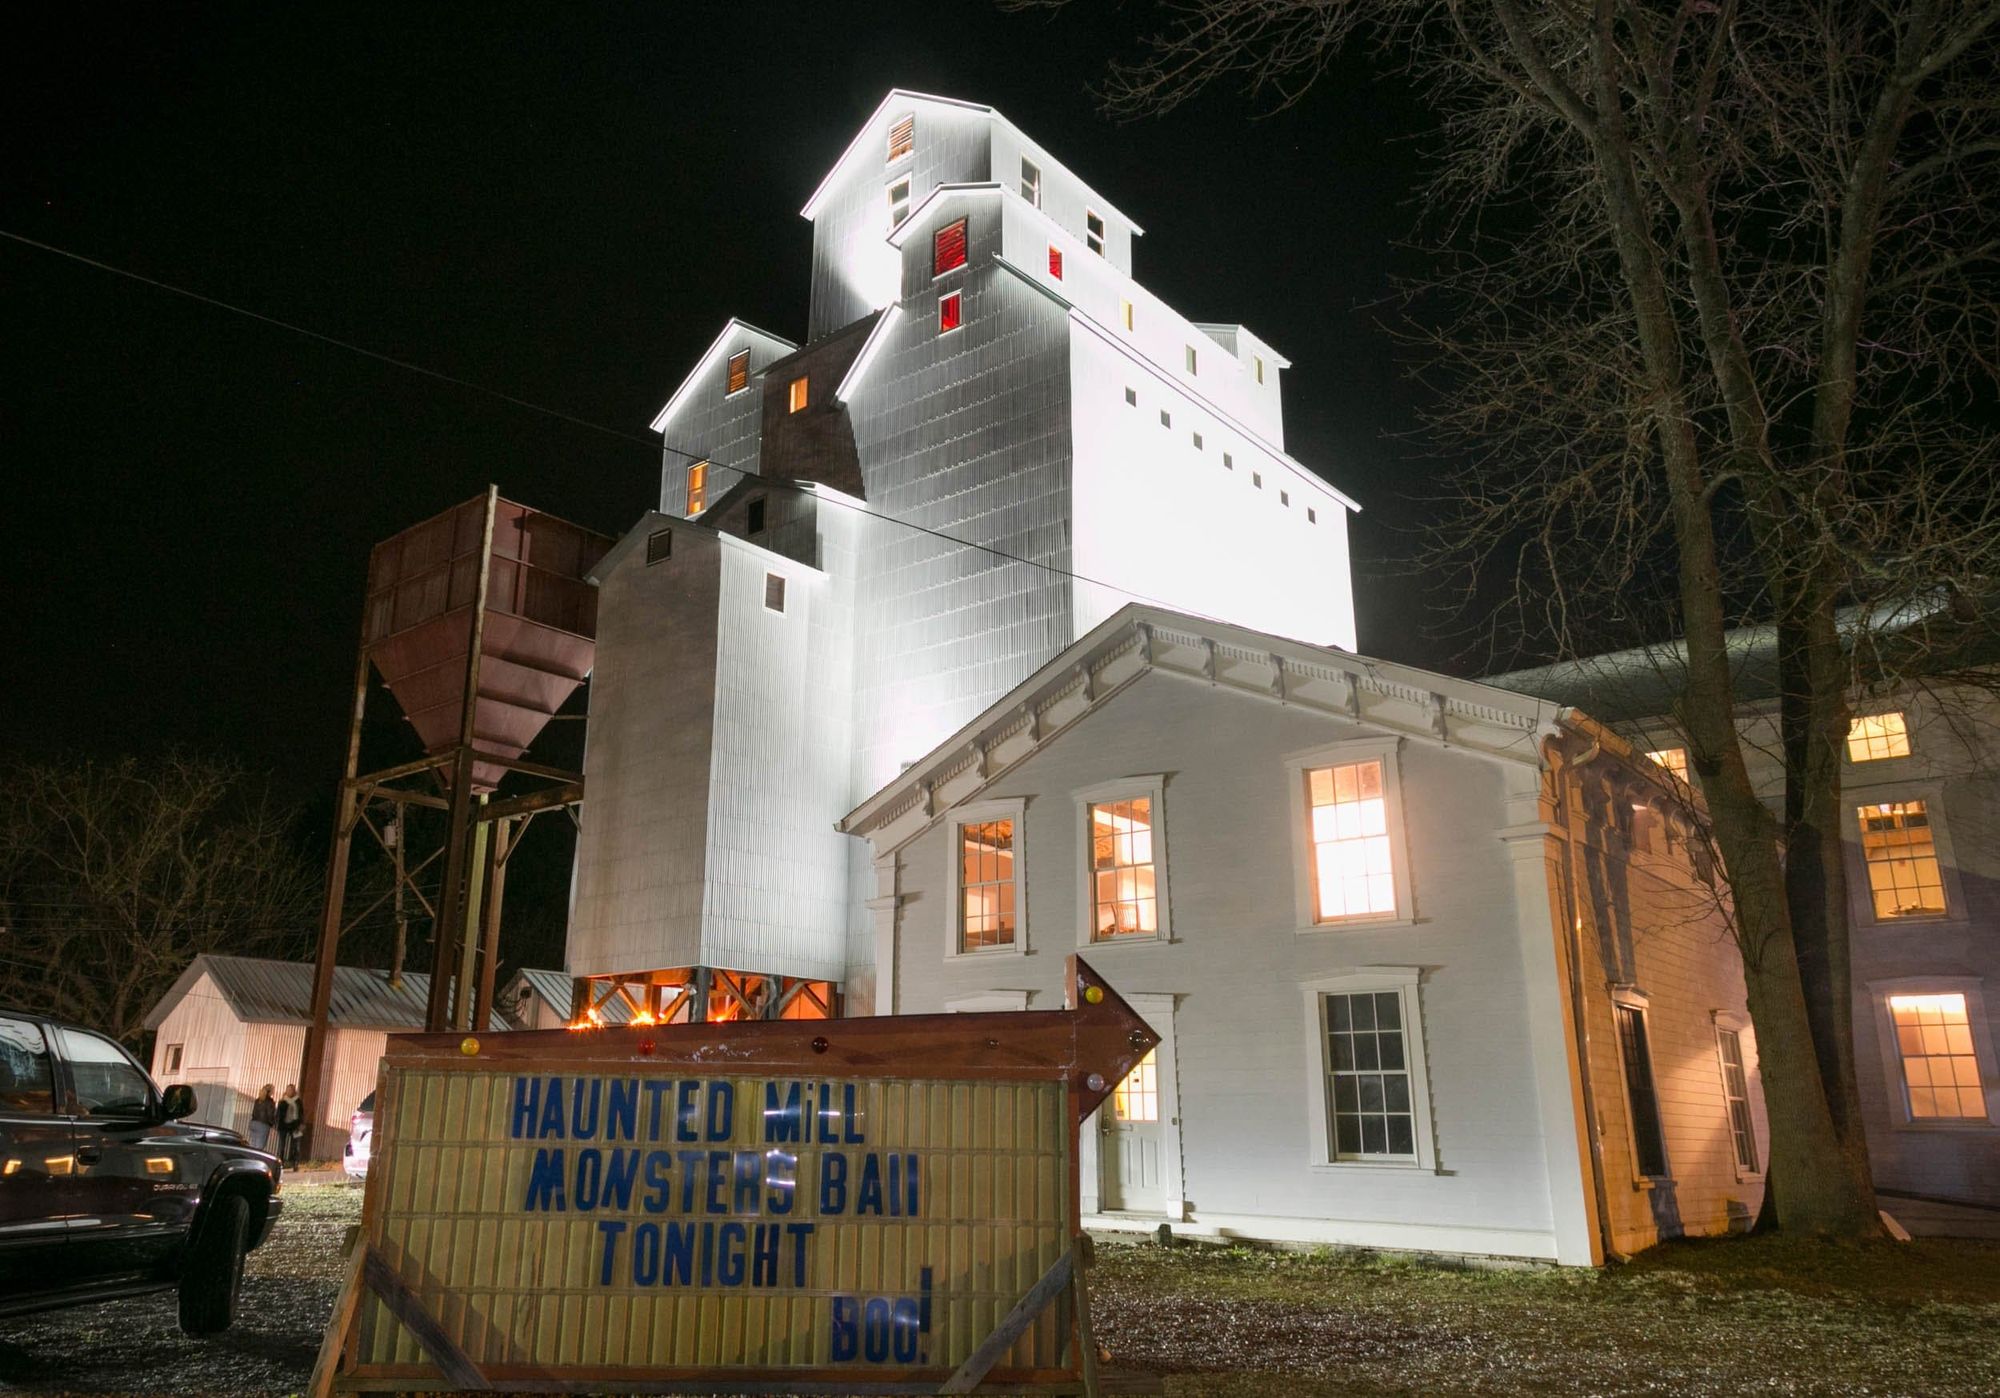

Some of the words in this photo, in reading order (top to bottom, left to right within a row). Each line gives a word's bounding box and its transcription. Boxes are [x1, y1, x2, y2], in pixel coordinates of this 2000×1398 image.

[511, 1077, 734, 1142] HAUNTED
[525, 1148, 797, 1215] MONSTERS
[600, 1221, 815, 1288] TONIGHT
[831, 1267, 933, 1364] BOO!
